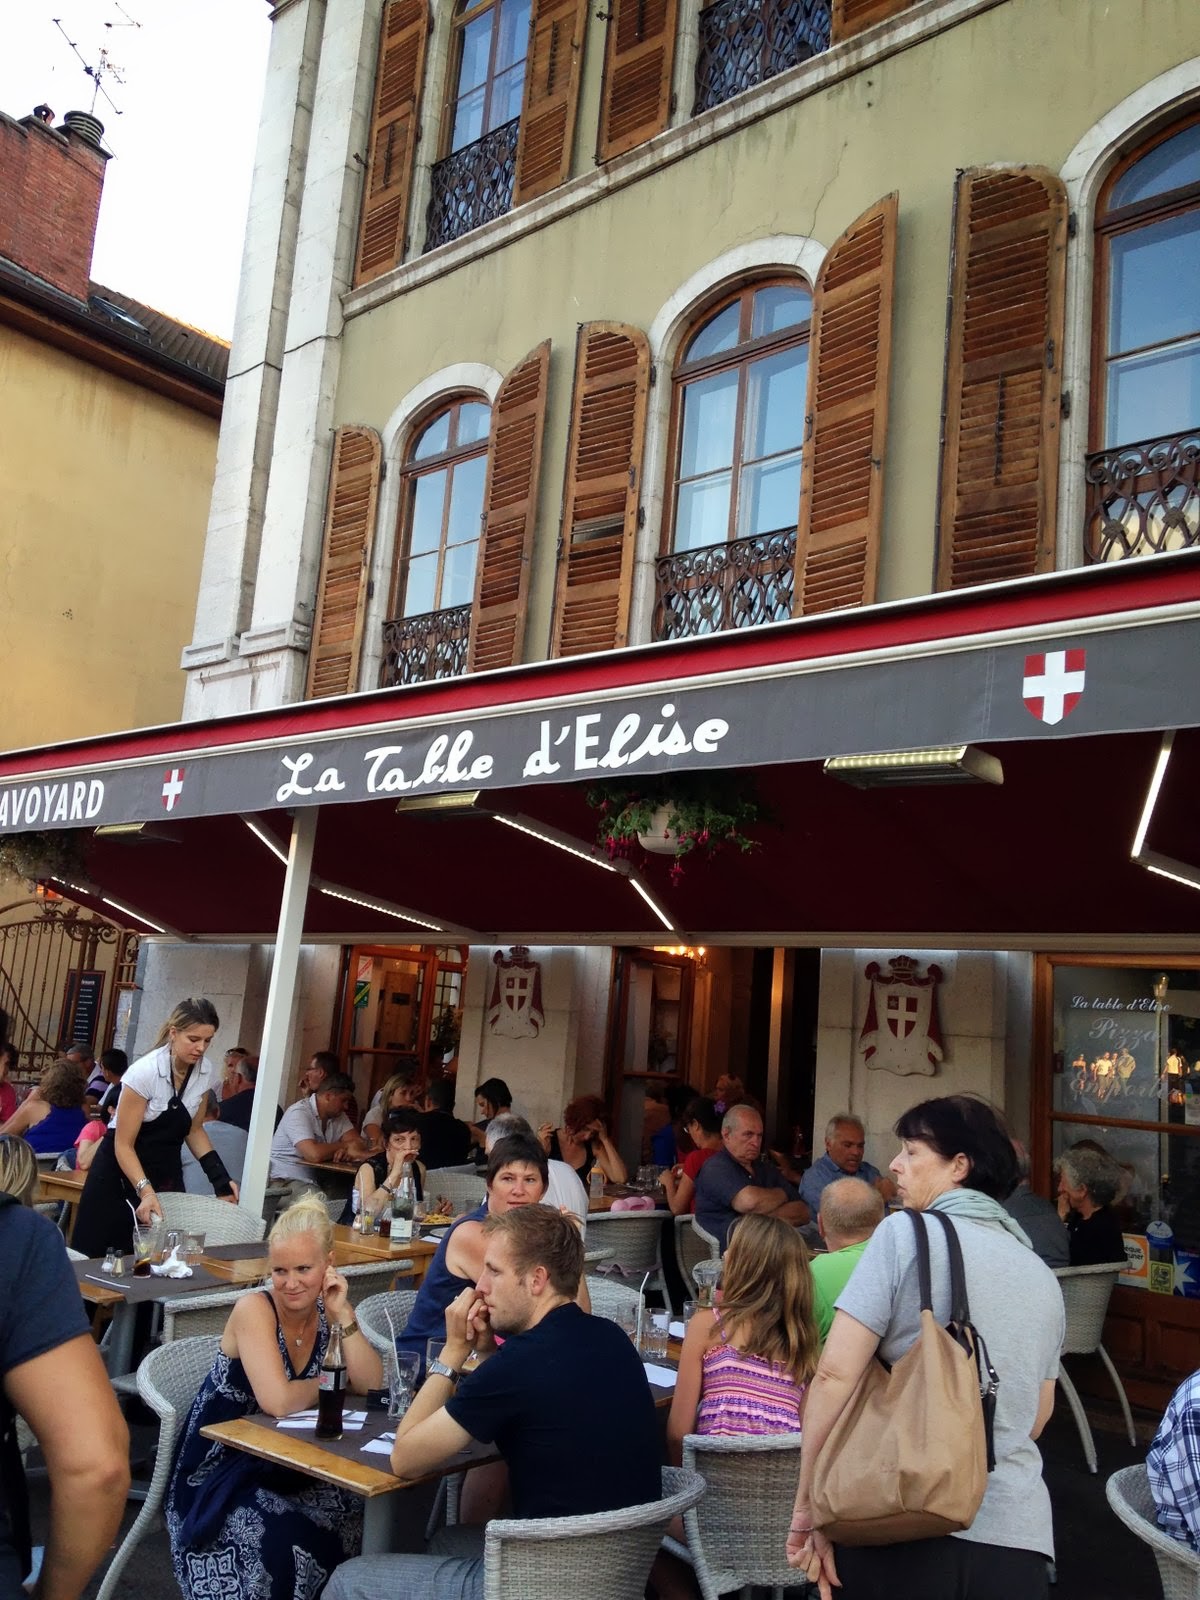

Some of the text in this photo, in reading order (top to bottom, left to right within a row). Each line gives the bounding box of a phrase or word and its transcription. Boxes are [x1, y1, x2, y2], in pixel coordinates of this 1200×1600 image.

[277, 703, 729, 802] La Table d'Elise
[0, 779, 104, 827] AVOYARD
[1071, 995, 1089, 1009] La
[1092, 997, 1124, 1010] table
[1089, 1017, 1161, 1050] Pizza
